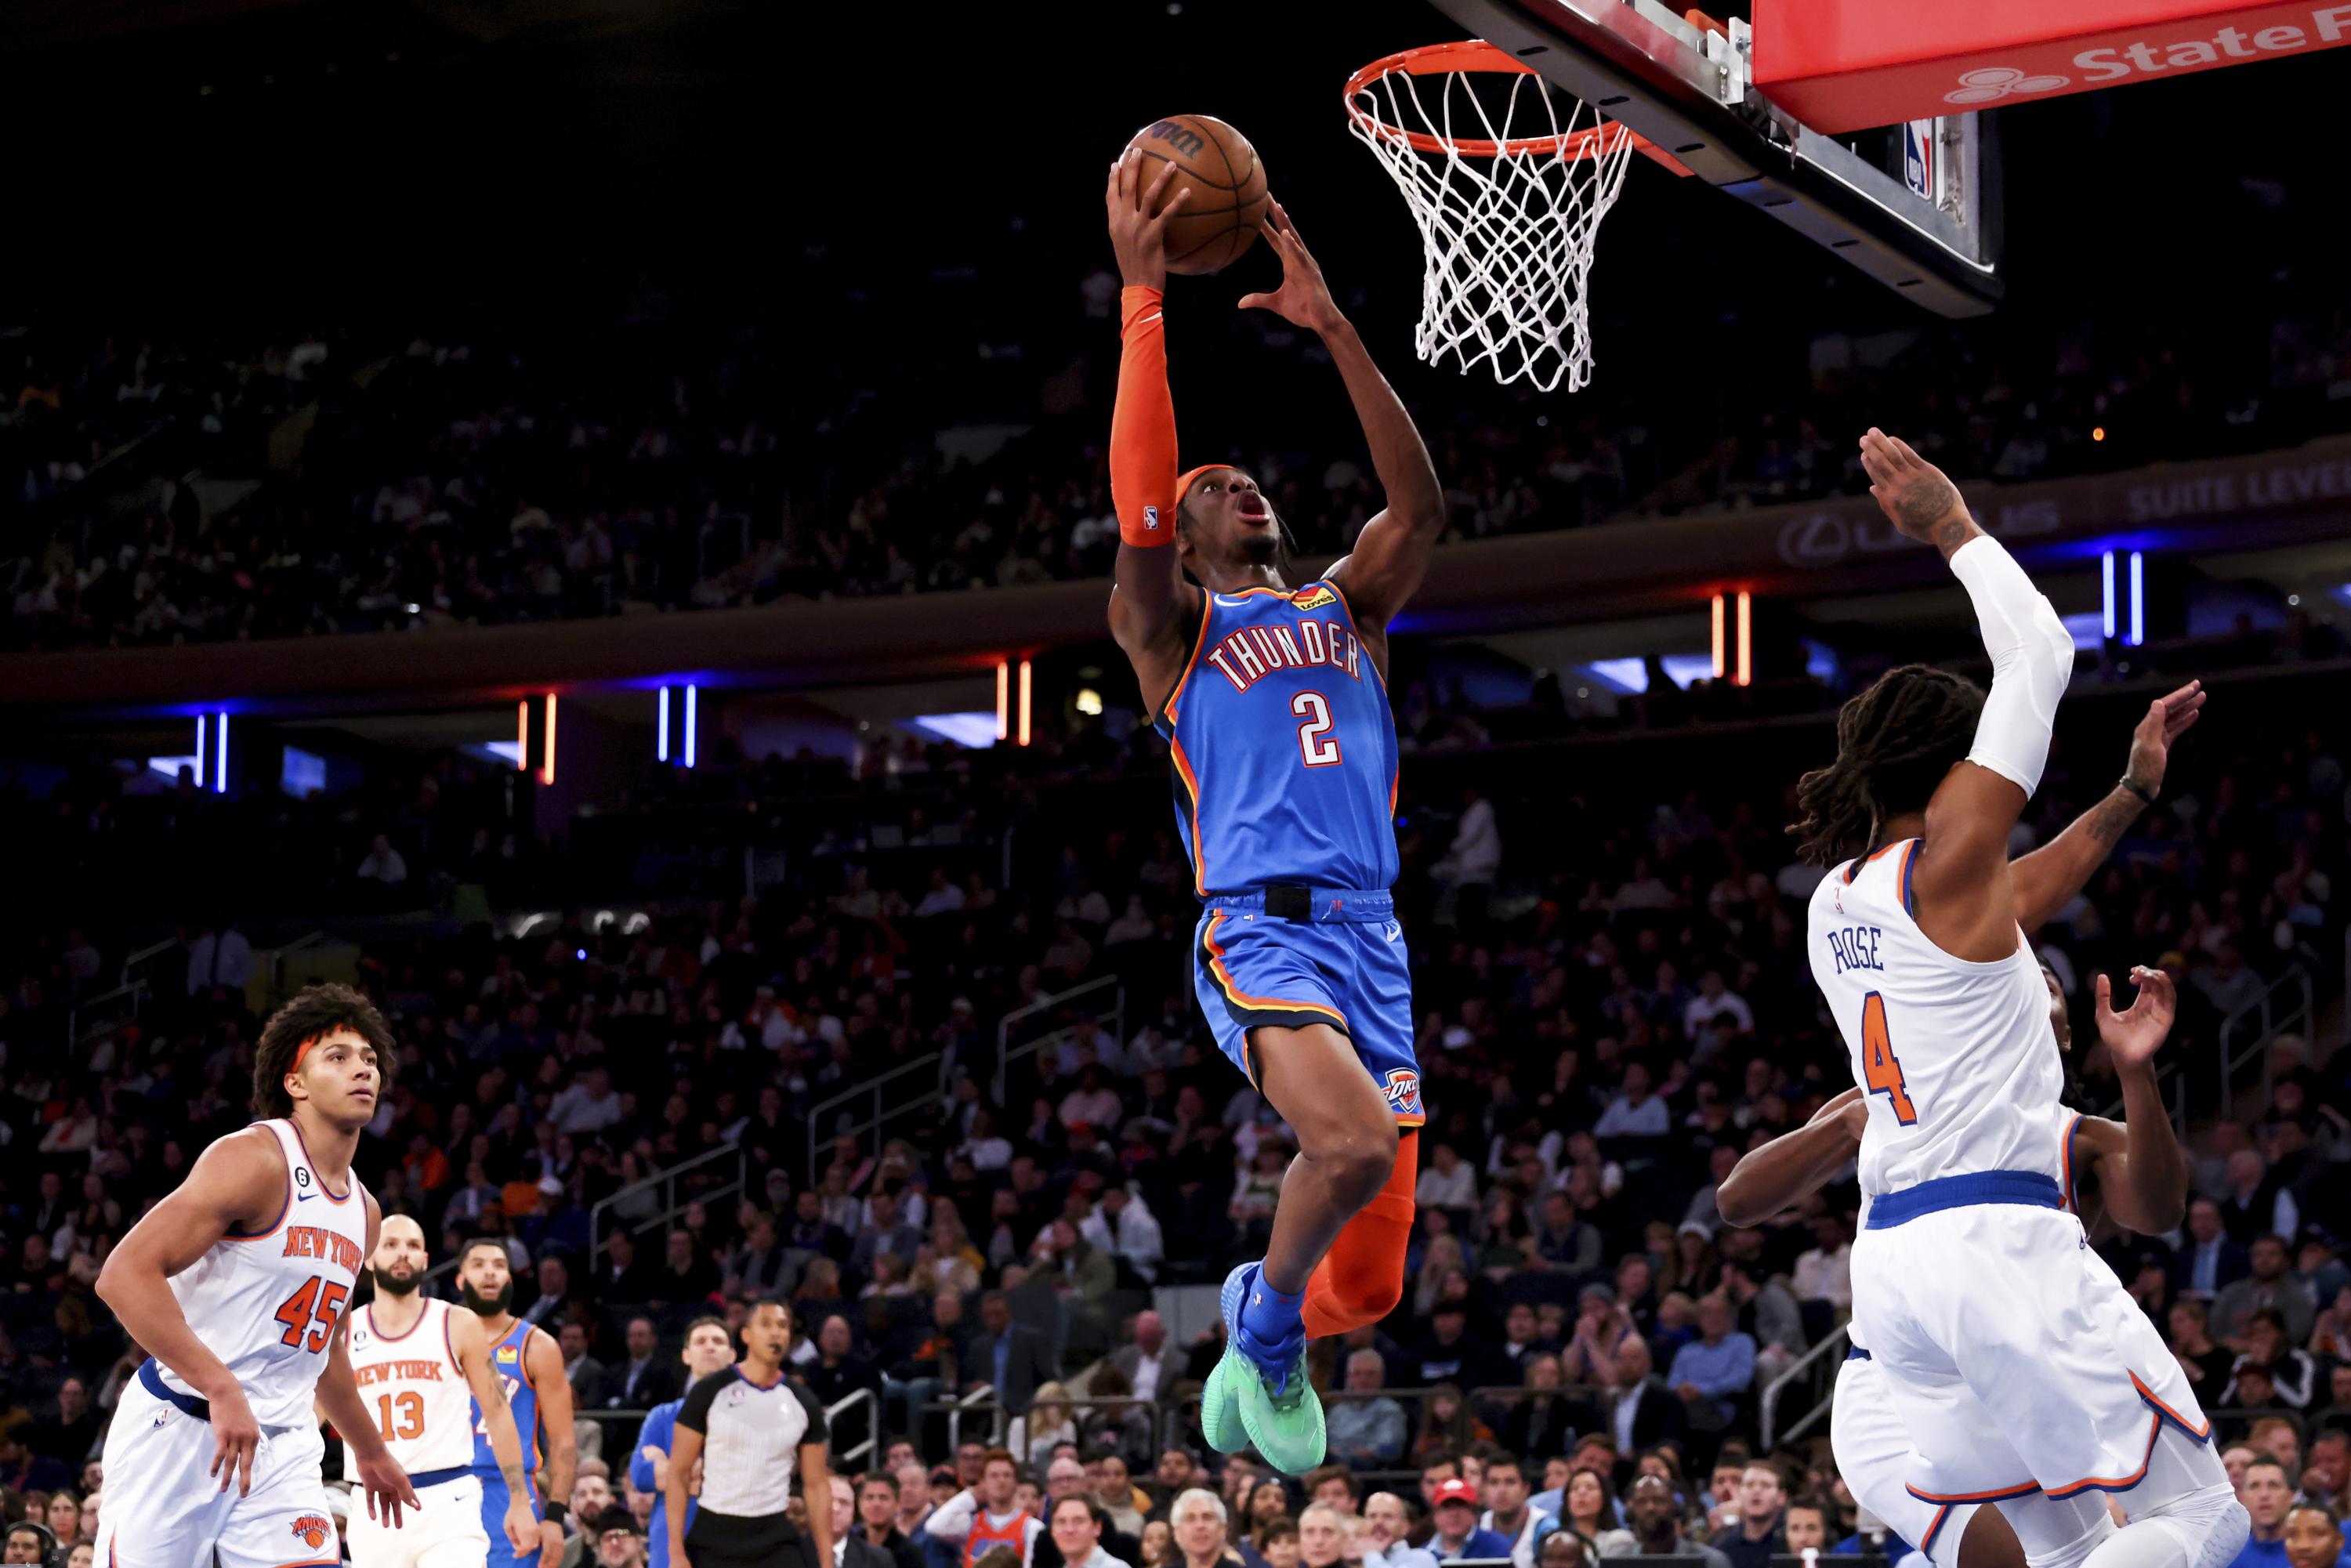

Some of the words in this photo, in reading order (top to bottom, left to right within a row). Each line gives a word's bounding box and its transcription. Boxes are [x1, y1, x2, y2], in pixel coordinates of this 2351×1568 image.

[2073, 26, 2307, 81] State
[2129, 475, 2233, 523] SUITE
[1205, 619, 1361, 694] THUNDER
[1290, 690, 1342, 768] 2
[1827, 926, 1884, 975] ROSE
[1861, 990, 1918, 1127] 4
[282, 1226, 329, 1259] NEW
[330, 1230, 363, 1276] YORK
[274, 1274, 350, 1355] 45
[393, 1359, 444, 1383] YORK
[378, 1389, 426, 1442] 13
